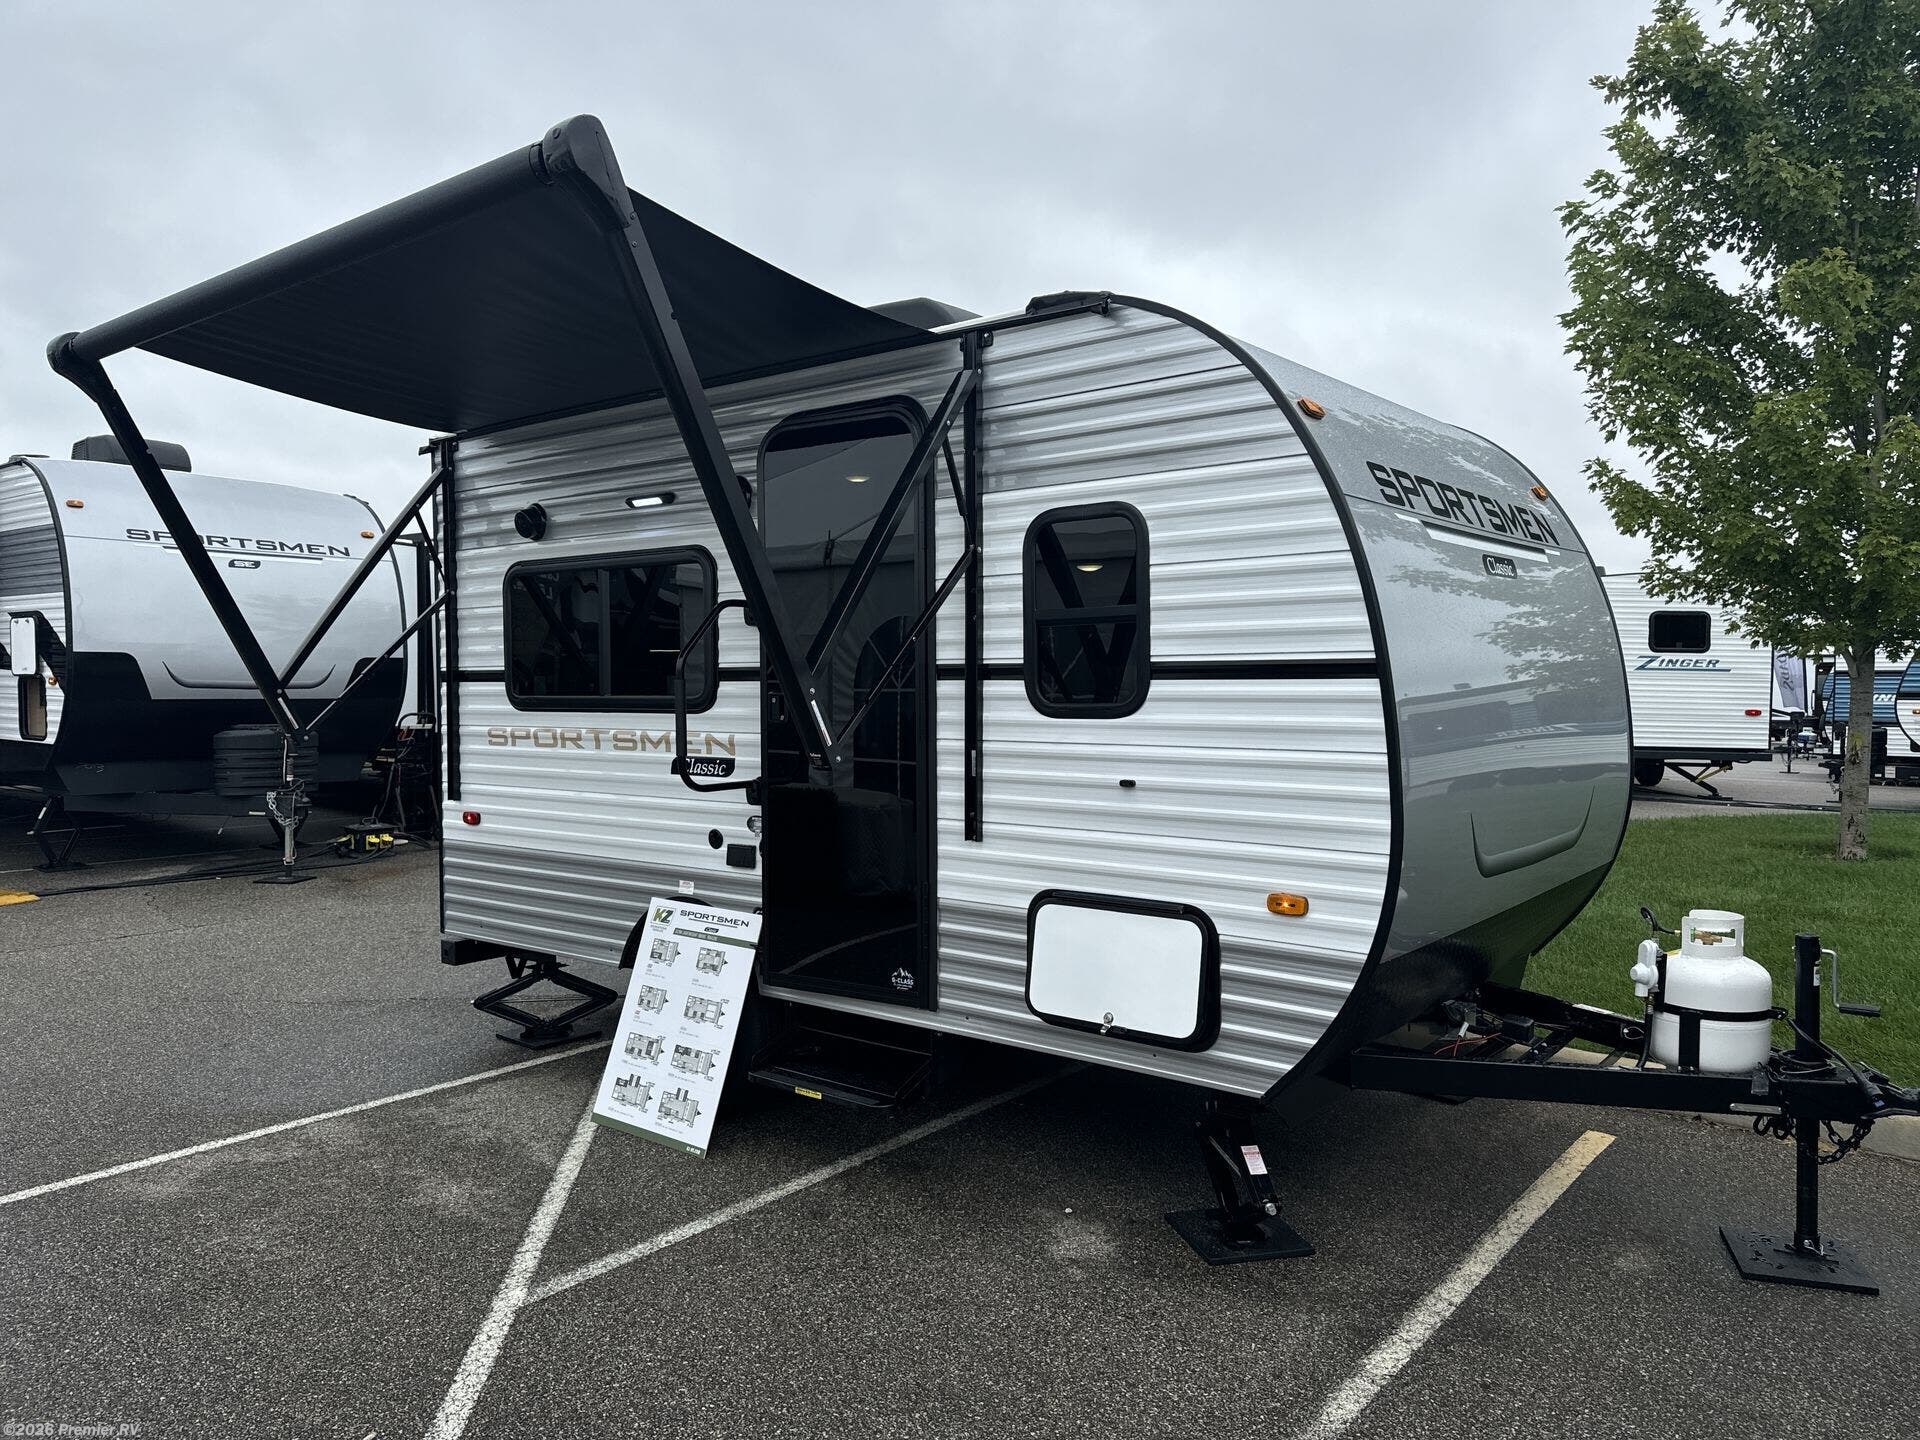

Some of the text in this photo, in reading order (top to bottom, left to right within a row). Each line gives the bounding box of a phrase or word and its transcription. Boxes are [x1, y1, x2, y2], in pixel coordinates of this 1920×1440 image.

[1366, 460, 1561, 547] SPORTSMEN
[126, 528, 350, 556] SPRTSMEN
[1486, 556, 1515, 577] Classic
[1635, 655, 1731, 672] ZINGER
[680, 909, 750, 928] SPORTSMEN
